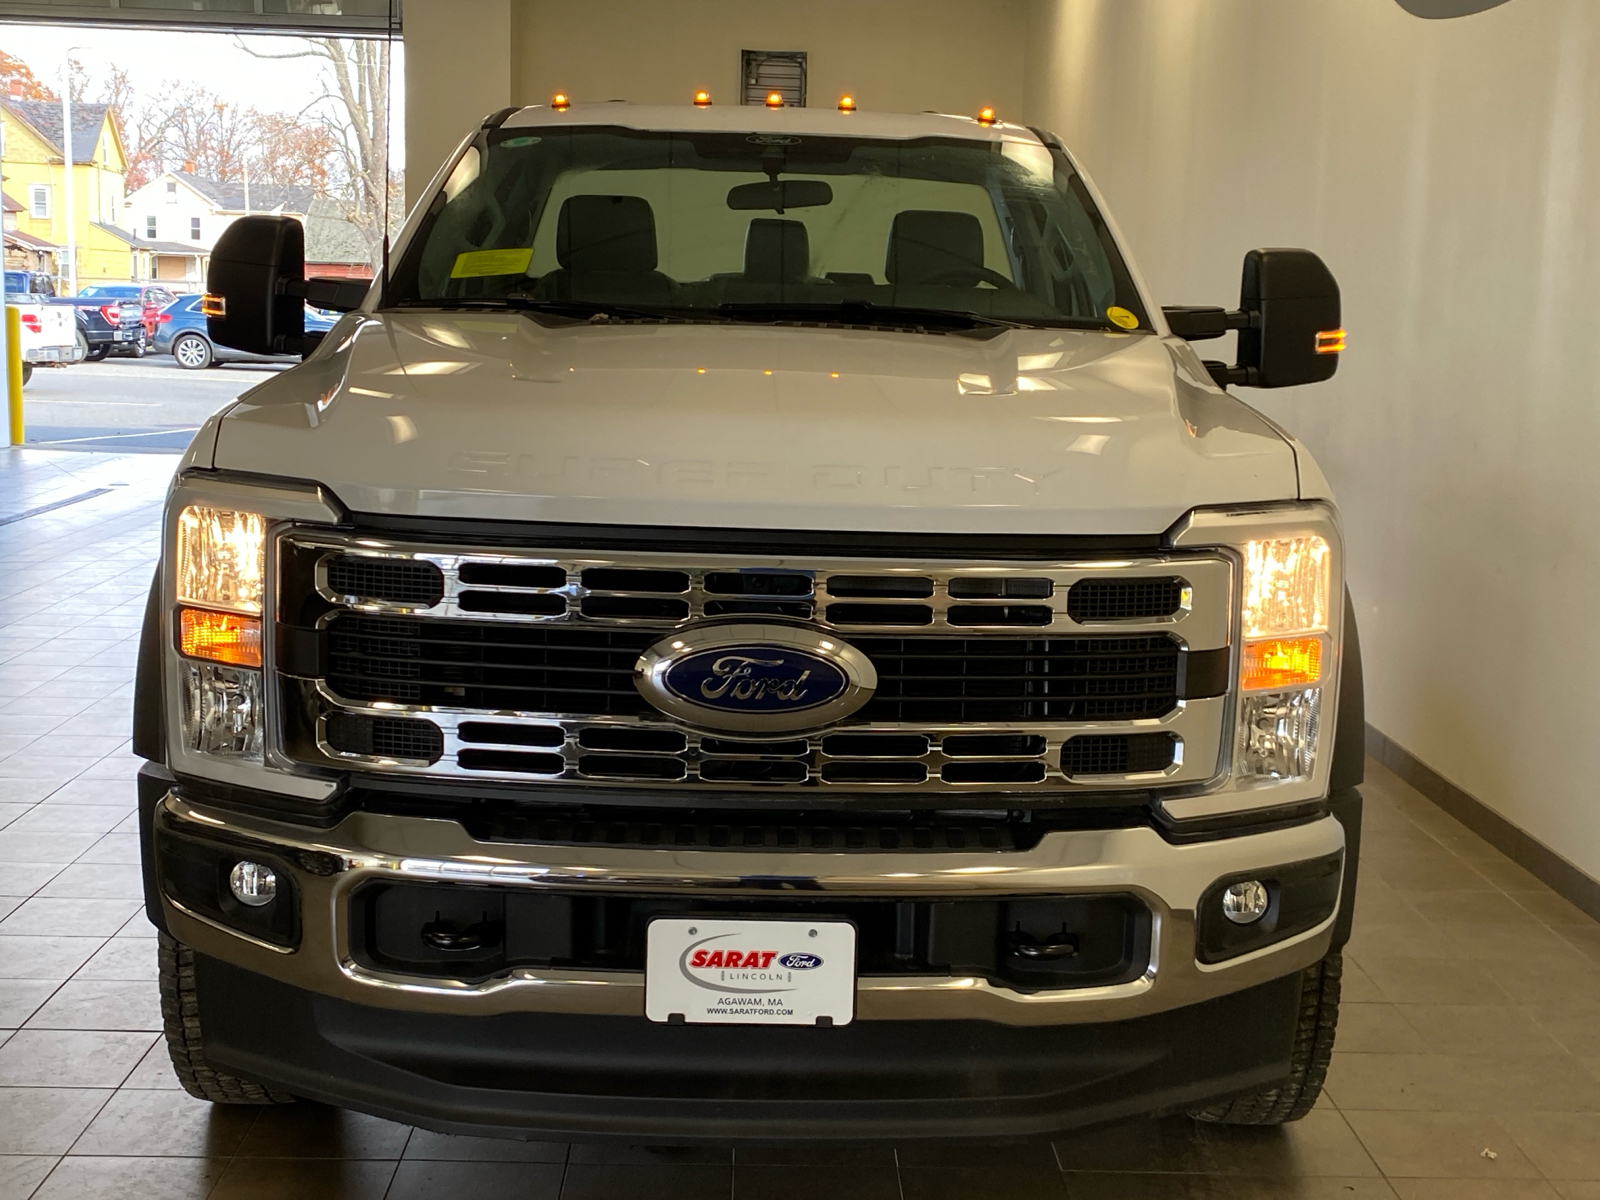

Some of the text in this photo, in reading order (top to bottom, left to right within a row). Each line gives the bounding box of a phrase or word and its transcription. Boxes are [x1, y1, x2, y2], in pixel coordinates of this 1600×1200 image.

[811, 464, 1068, 495] DUTY
[701, 656, 811, 701] Ford
[690, 949, 779, 969] SARAT
[729, 972, 784, 981] LINCOLN
[717, 997, 783, 1007] AGAWAM, MA
[706, 1007, 794, 1016] WWW.SARATFORD.COM
